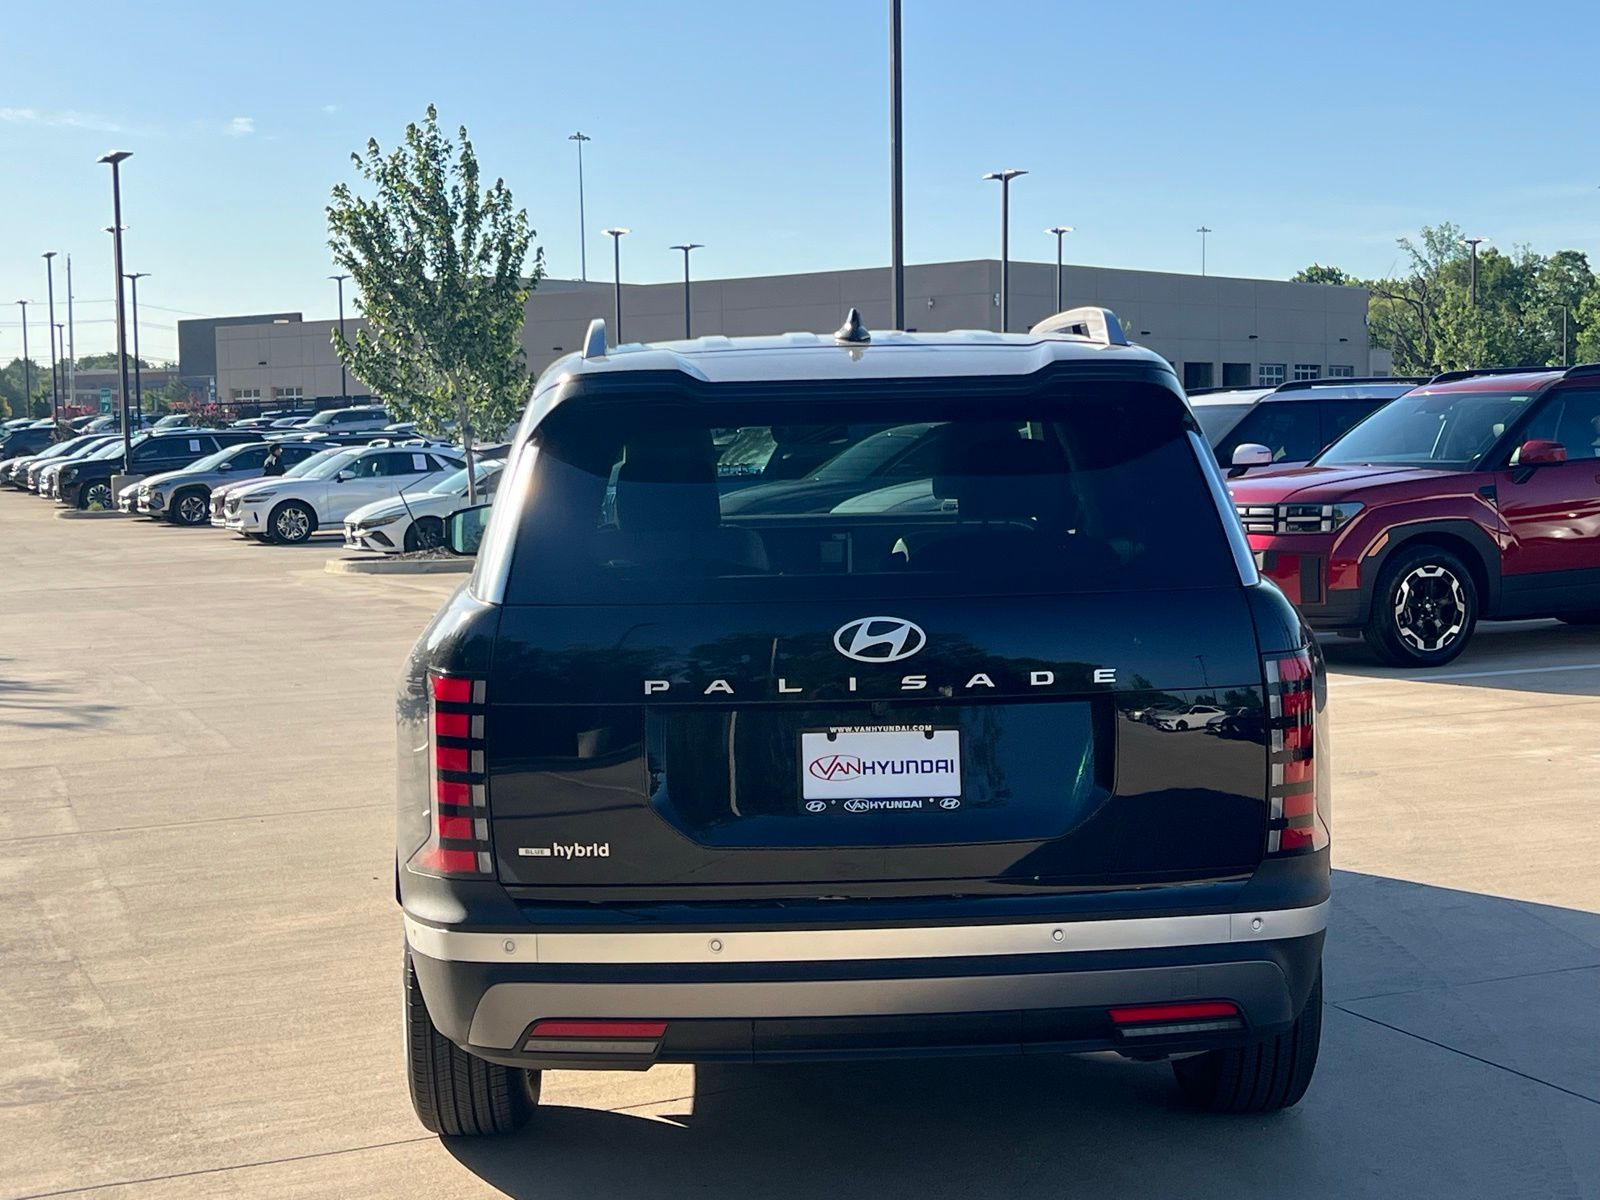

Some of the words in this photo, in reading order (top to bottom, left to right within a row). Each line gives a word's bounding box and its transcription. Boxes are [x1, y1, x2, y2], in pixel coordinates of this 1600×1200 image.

[644, 668, 1116, 695] PALISADE
[829, 724, 932, 733] WWW.VANHYUNDAI.COM
[553, 842, 610, 860] hybrid
